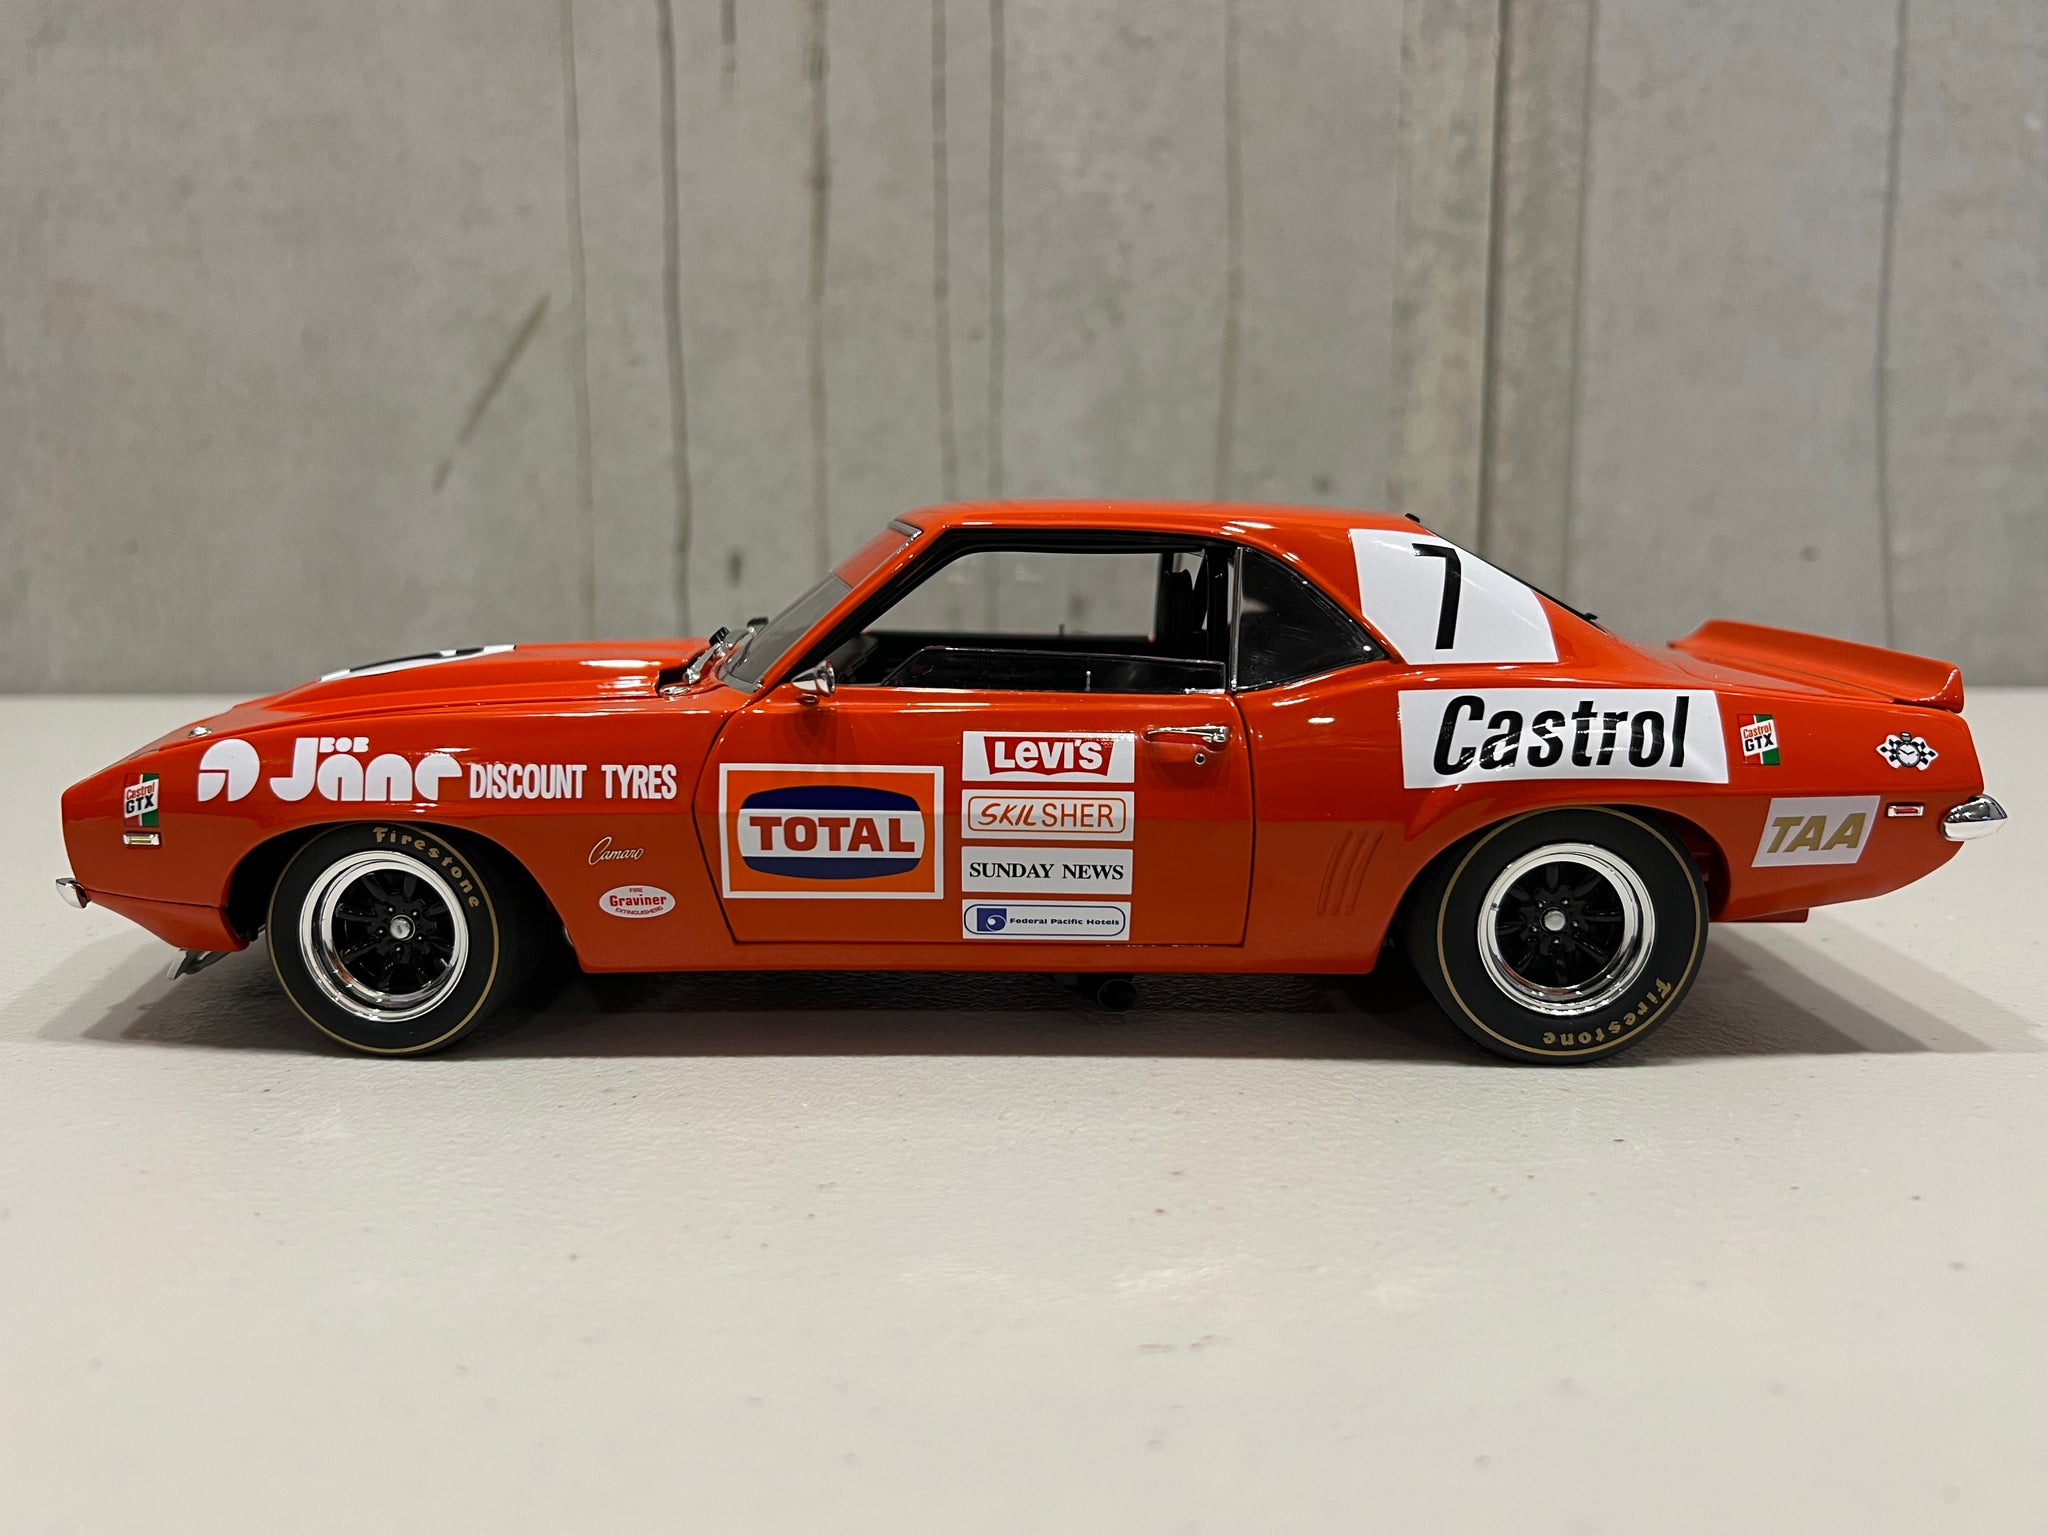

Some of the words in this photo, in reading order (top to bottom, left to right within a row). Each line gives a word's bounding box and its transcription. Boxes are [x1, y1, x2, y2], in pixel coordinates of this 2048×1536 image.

[1412, 543, 1461, 649] 7
[1433, 694, 1689, 775] Castrol
[1743, 722, 1772, 738] Castrol
[1745, 733, 1774, 752] GTX
[319, 736, 369, 752] BOB
[126, 781, 155, 800] Castrol
[470, 764, 587, 799] DISCOUNT
[602, 764, 677, 799] TYRES
[126, 793, 155, 814] GTX
[750, 815, 915, 852] TOTAL
[1766, 812, 1866, 853] TAA
[588, 836, 644, 865] Camaro
[373, 826, 480, 908] Firestone
[969, 861, 1055, 880] SUNDAY
[1062, 864, 1124, 880] NEWS
[609, 894, 667, 907] Graviner
[1009, 917, 1047, 925] Federal
[1050, 917, 1083, 925] Pacific
[1086, 918, 1119, 926] Hotels
[1543, 978, 1672, 1046] Firestone
